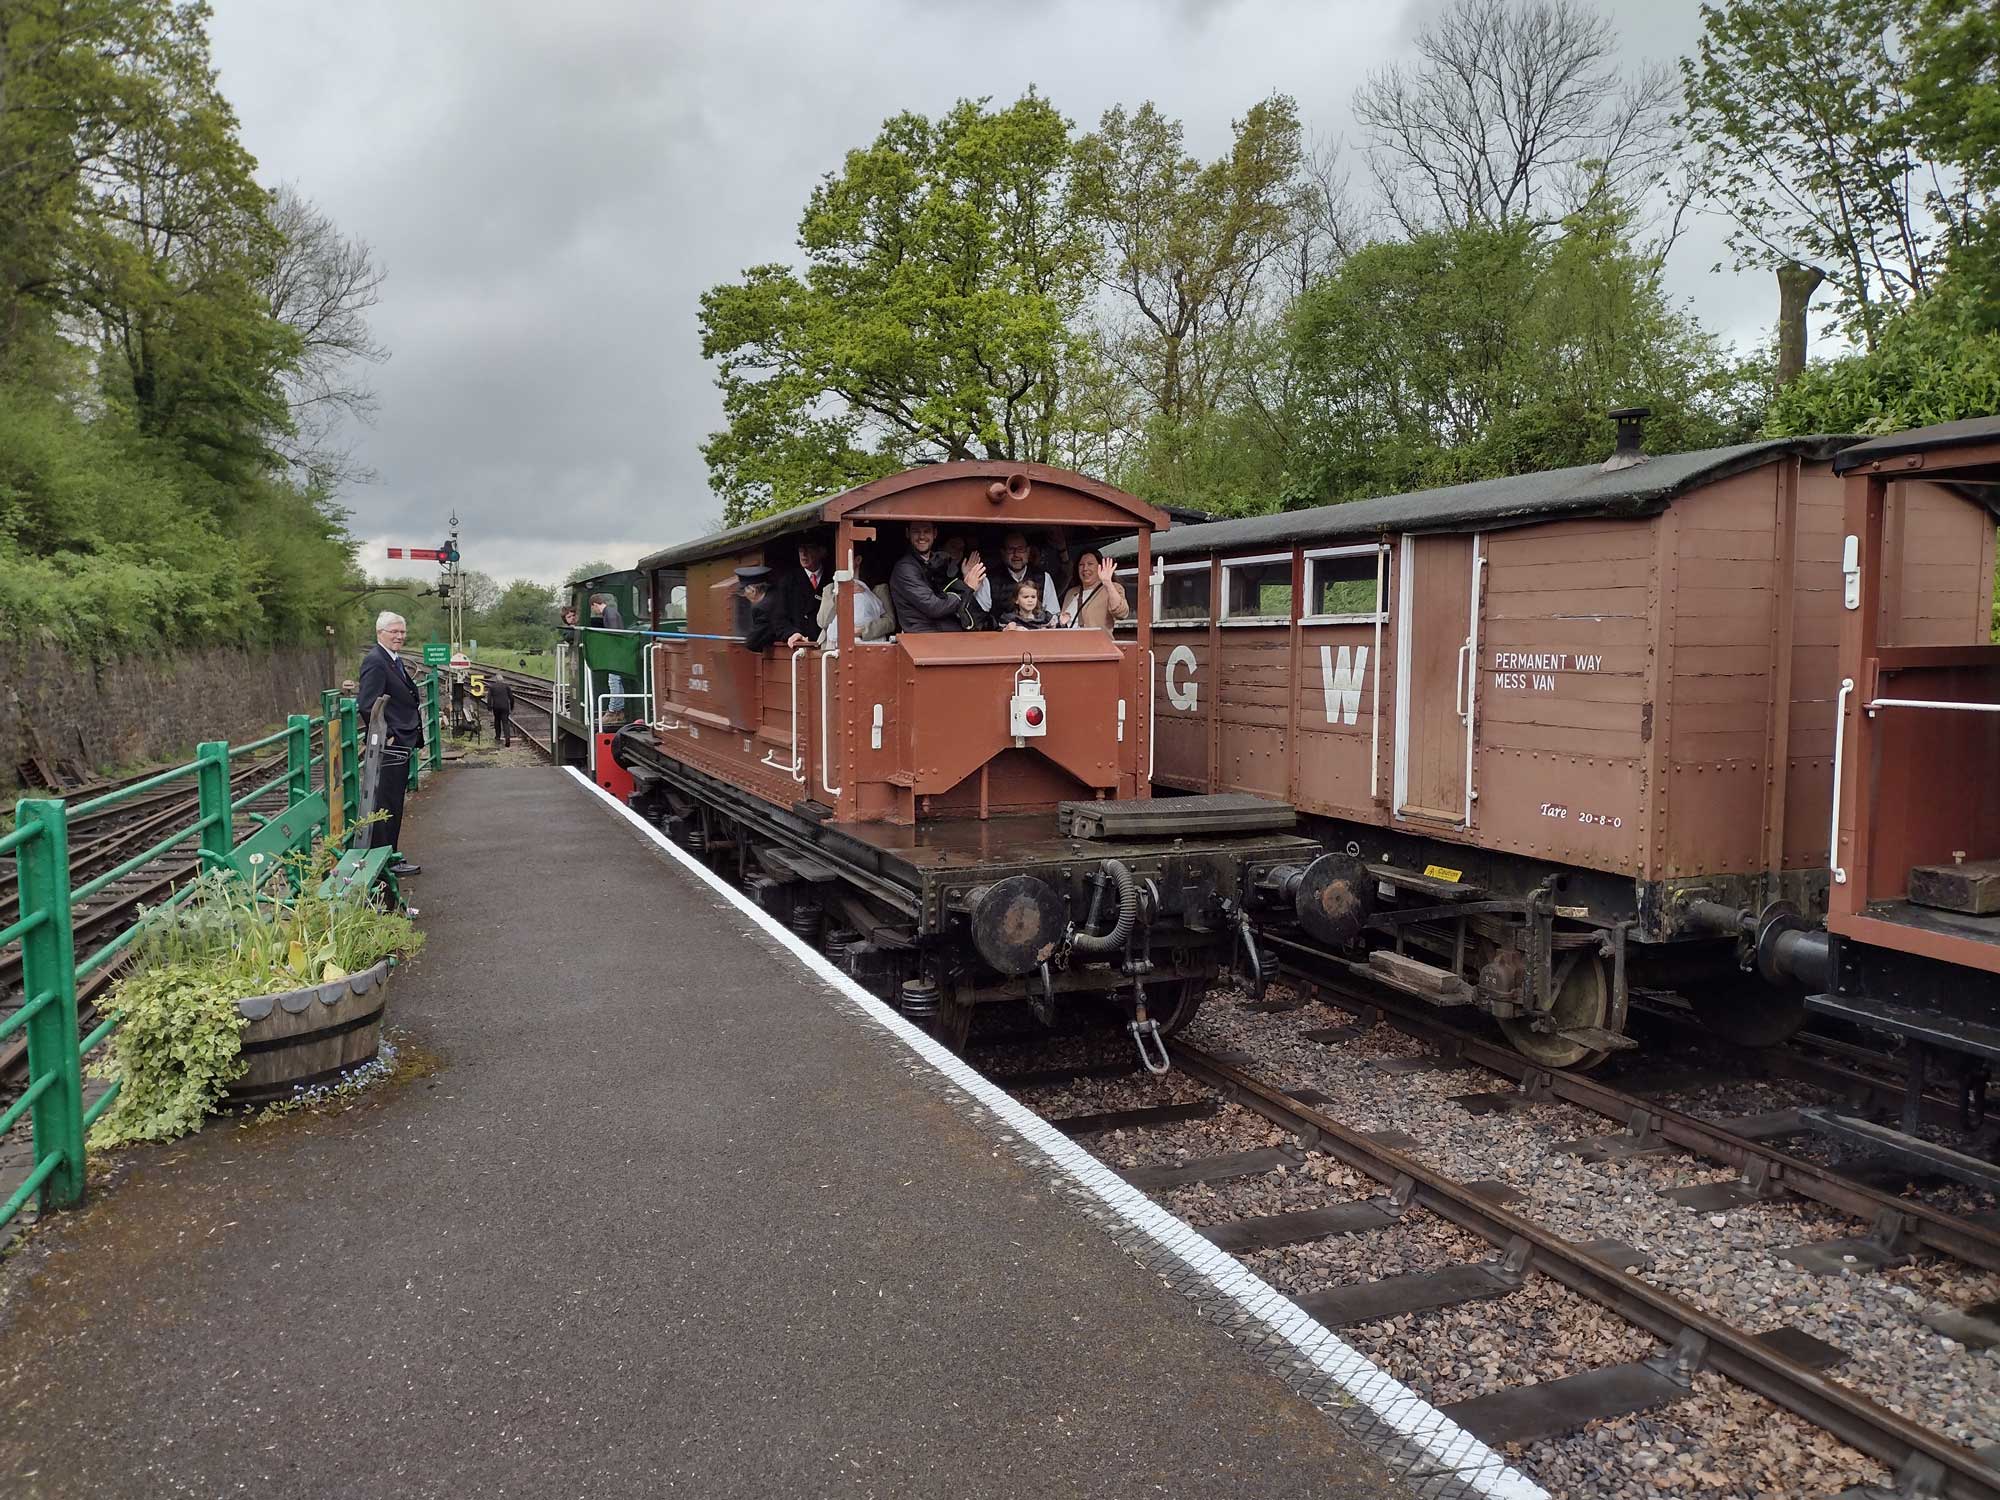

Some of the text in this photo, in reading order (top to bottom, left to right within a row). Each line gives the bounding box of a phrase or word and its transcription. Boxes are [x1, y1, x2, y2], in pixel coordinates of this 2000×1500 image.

[1495, 653, 1602, 671] PERMANENT WAY
[470, 675, 485, 697] 5
[1165, 645, 1369, 725] G W
[1495, 673, 1555, 691] MESS VAN
[1540, 803, 1622, 828] Tare 20-8-0
